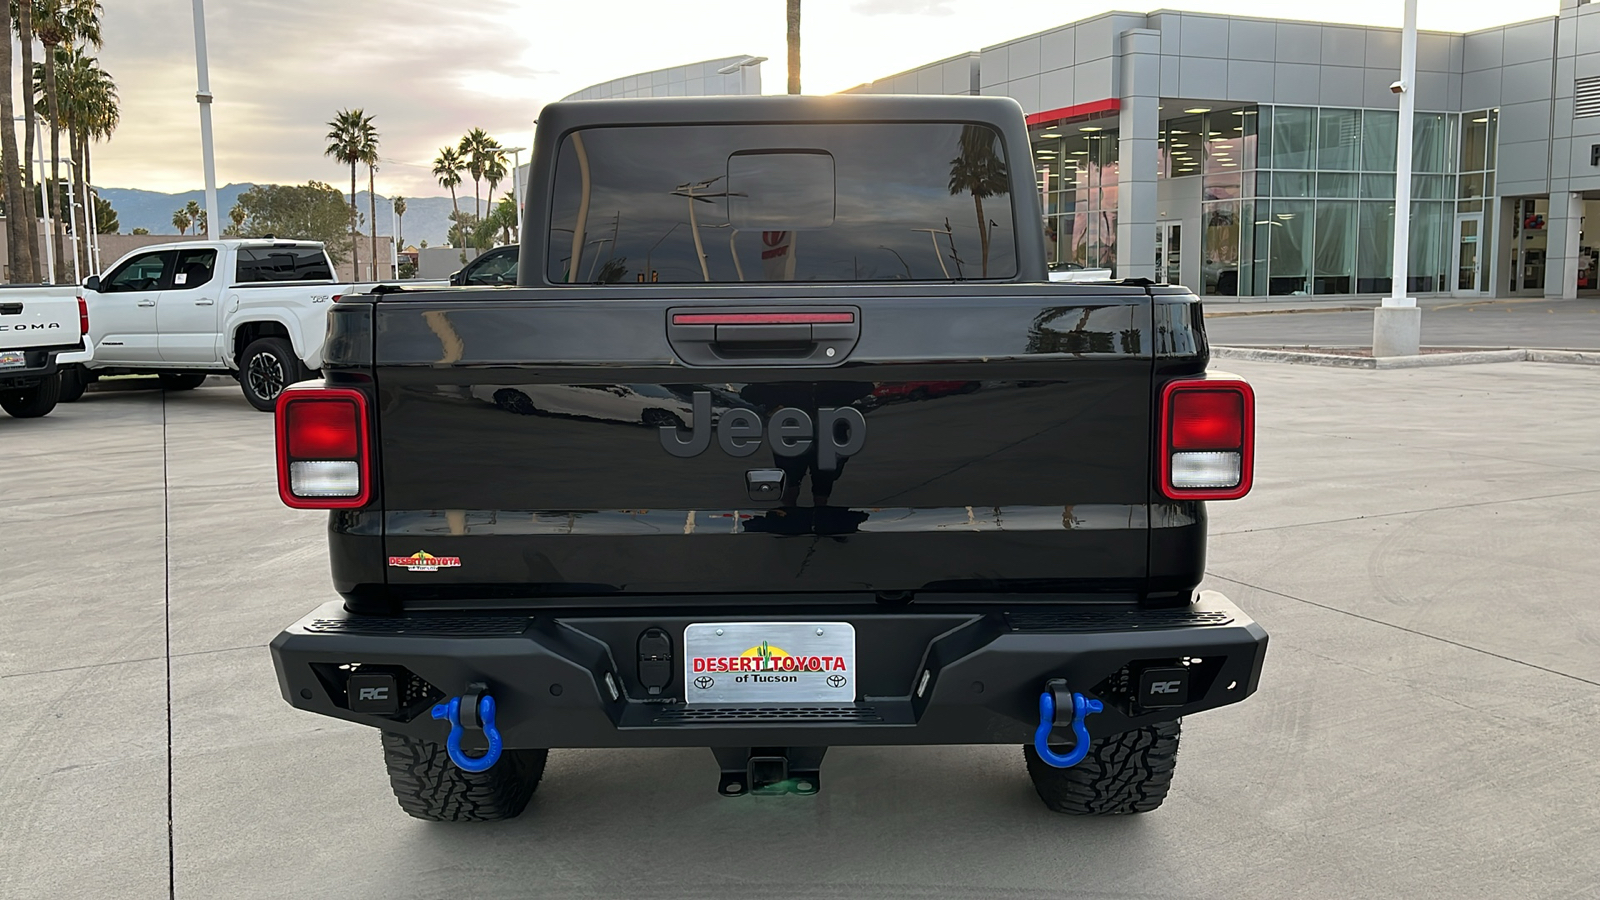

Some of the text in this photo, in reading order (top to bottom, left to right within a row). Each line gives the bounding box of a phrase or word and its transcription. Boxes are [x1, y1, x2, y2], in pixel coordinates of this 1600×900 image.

[659, 391, 867, 470] Jeep
[389, 557, 461, 565] DESERT TOYOTA
[693, 656, 847, 672] DESERT TOYOTA
[735, 674, 797, 683] of Tucson
[359, 687, 389, 701] RC
[1150, 680, 1182, 695] RC
